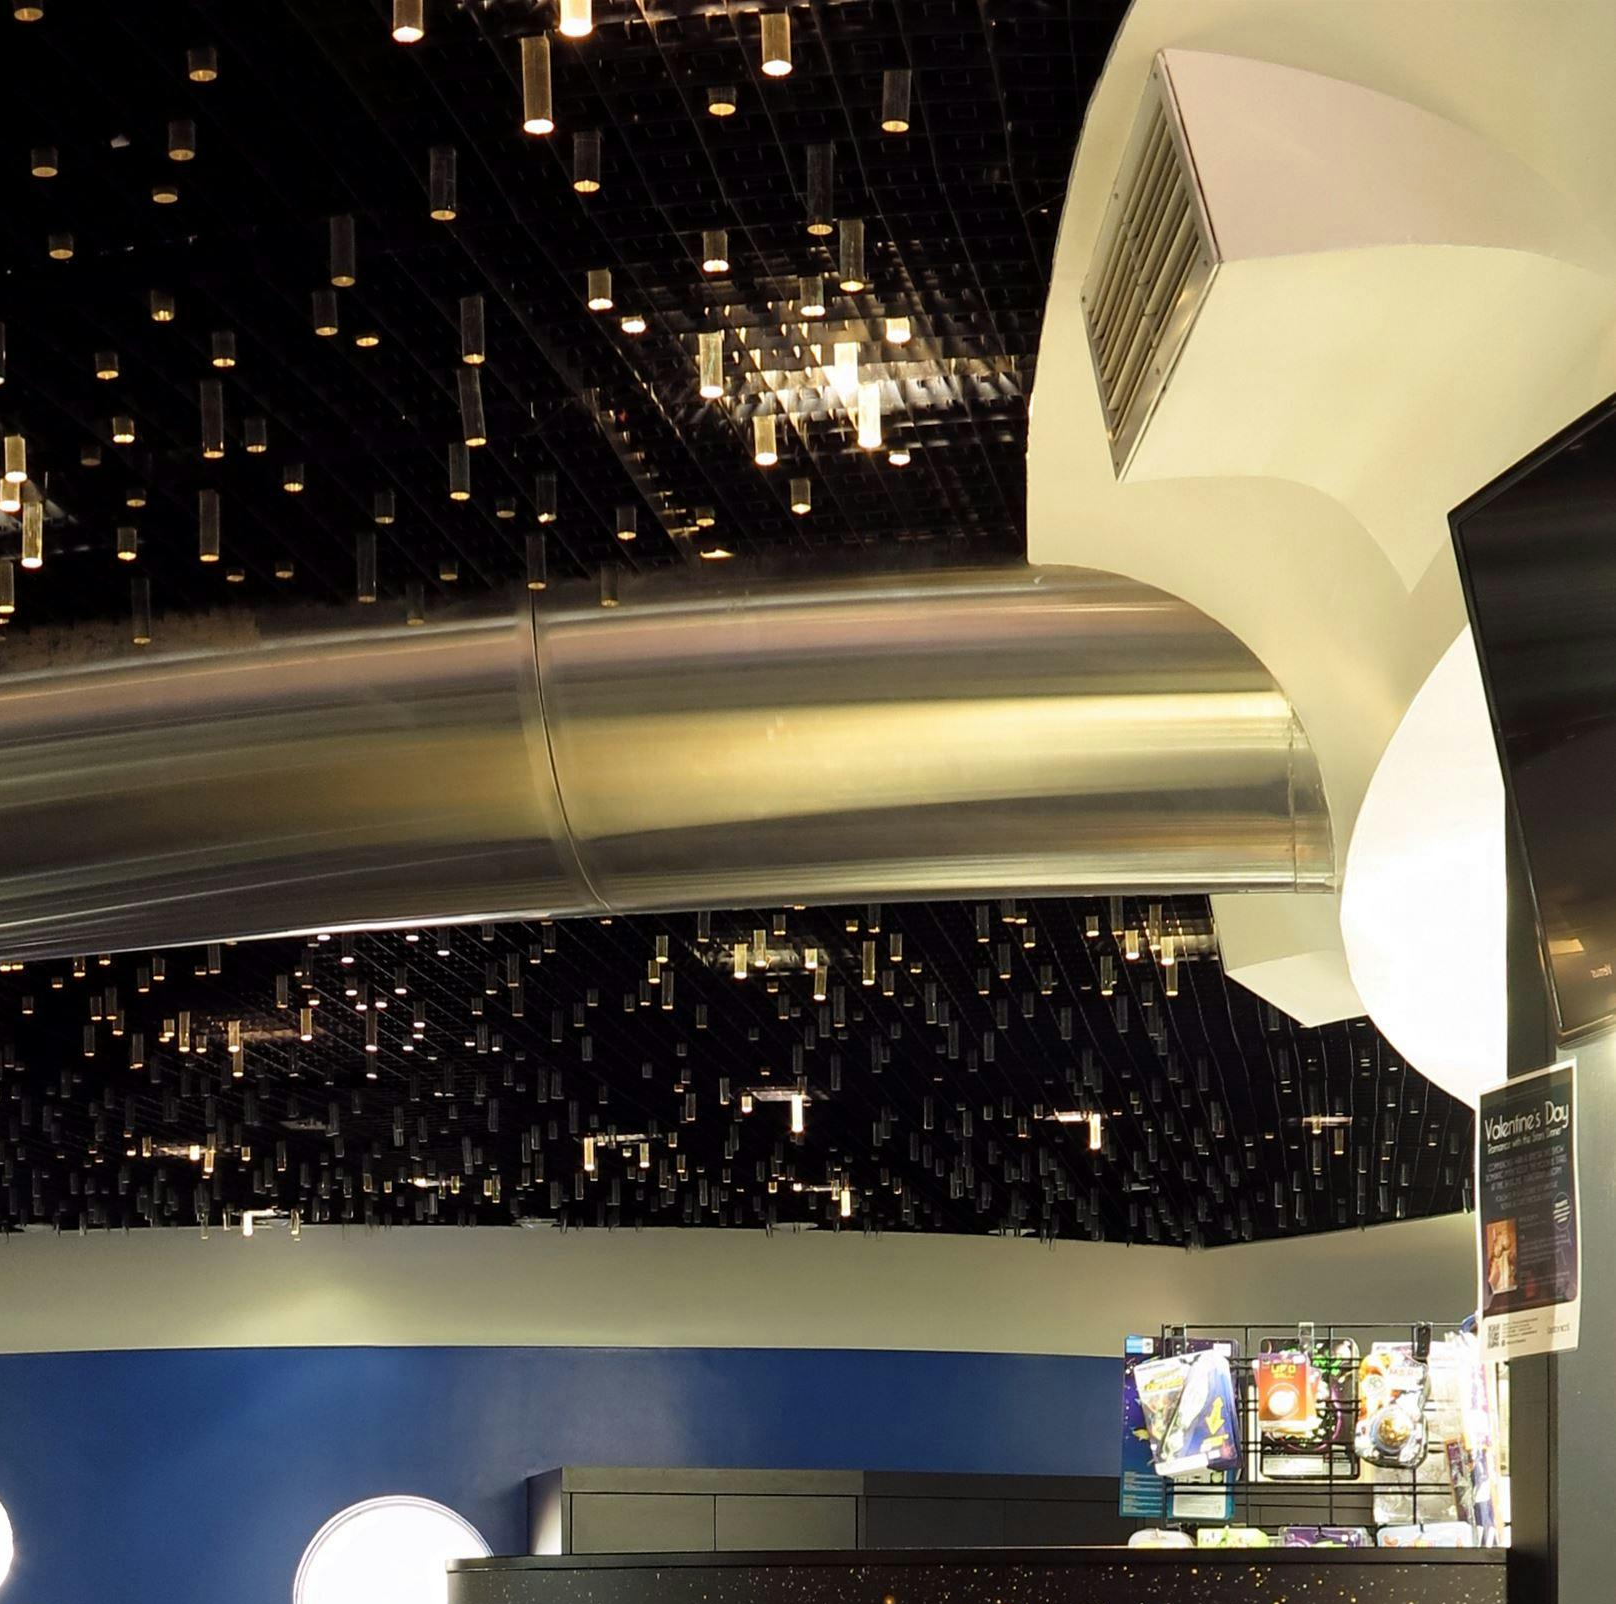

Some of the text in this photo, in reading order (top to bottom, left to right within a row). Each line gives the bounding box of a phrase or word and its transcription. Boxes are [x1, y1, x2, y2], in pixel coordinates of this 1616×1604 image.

[1485, 1101, 1569, 1141] Valentine's Day
[1271, 1364, 1296, 1374] UFO
